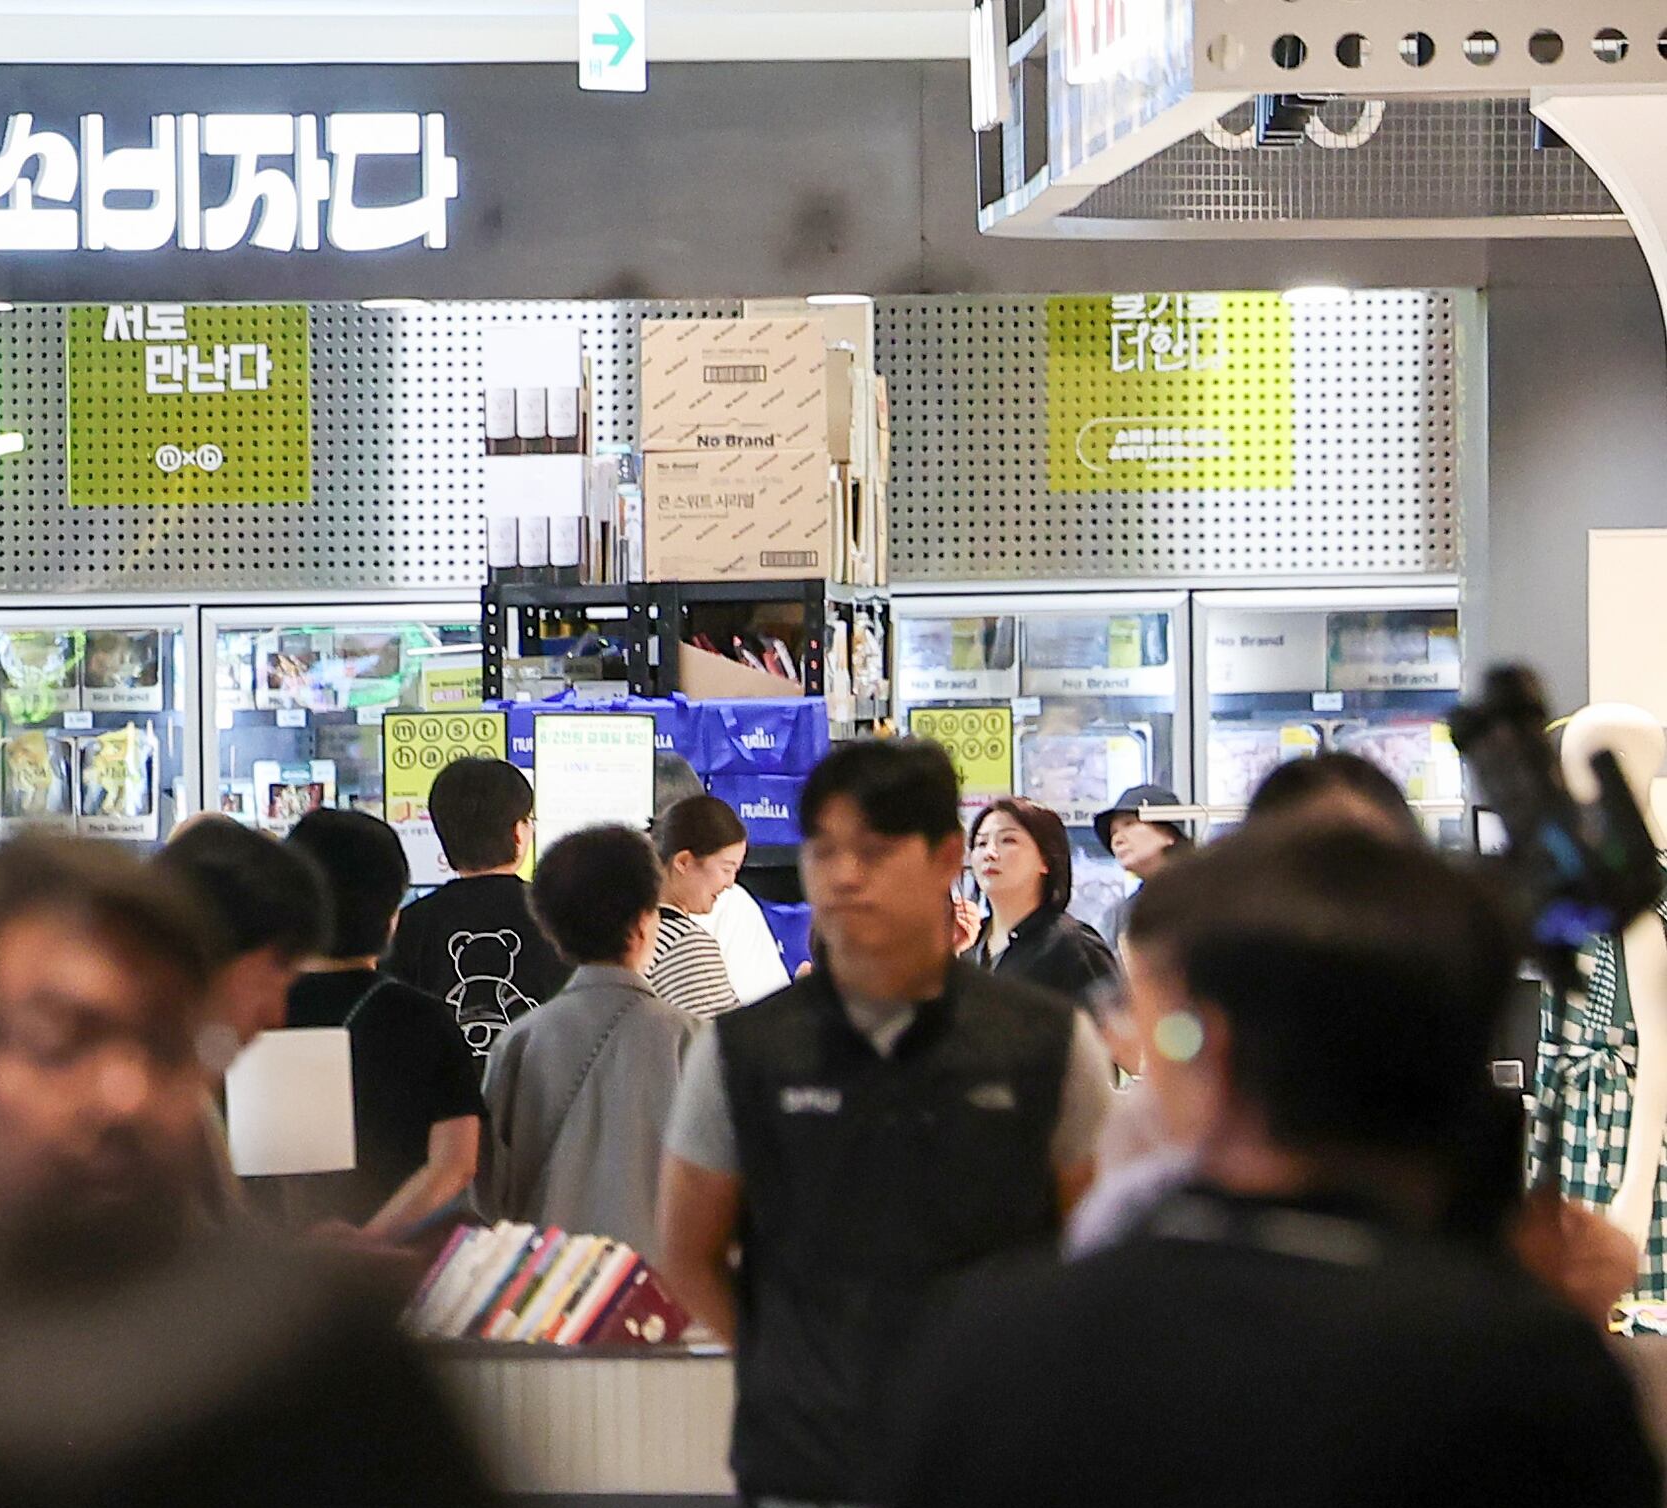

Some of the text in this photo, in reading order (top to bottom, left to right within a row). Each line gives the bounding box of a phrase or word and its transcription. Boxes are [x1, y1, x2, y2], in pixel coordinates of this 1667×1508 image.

[104, 304, 187, 341] 서로
[1111, 322, 1228, 373] 더한다
[145, 344, 273, 394] 만난다
[697, 434, 775, 448] No Brand
[1240, 635, 1286, 647] Brand
[934, 678, 978, 690] Brand
[1086, 678, 1130, 690] Brand
[393, 719, 497, 741] must
